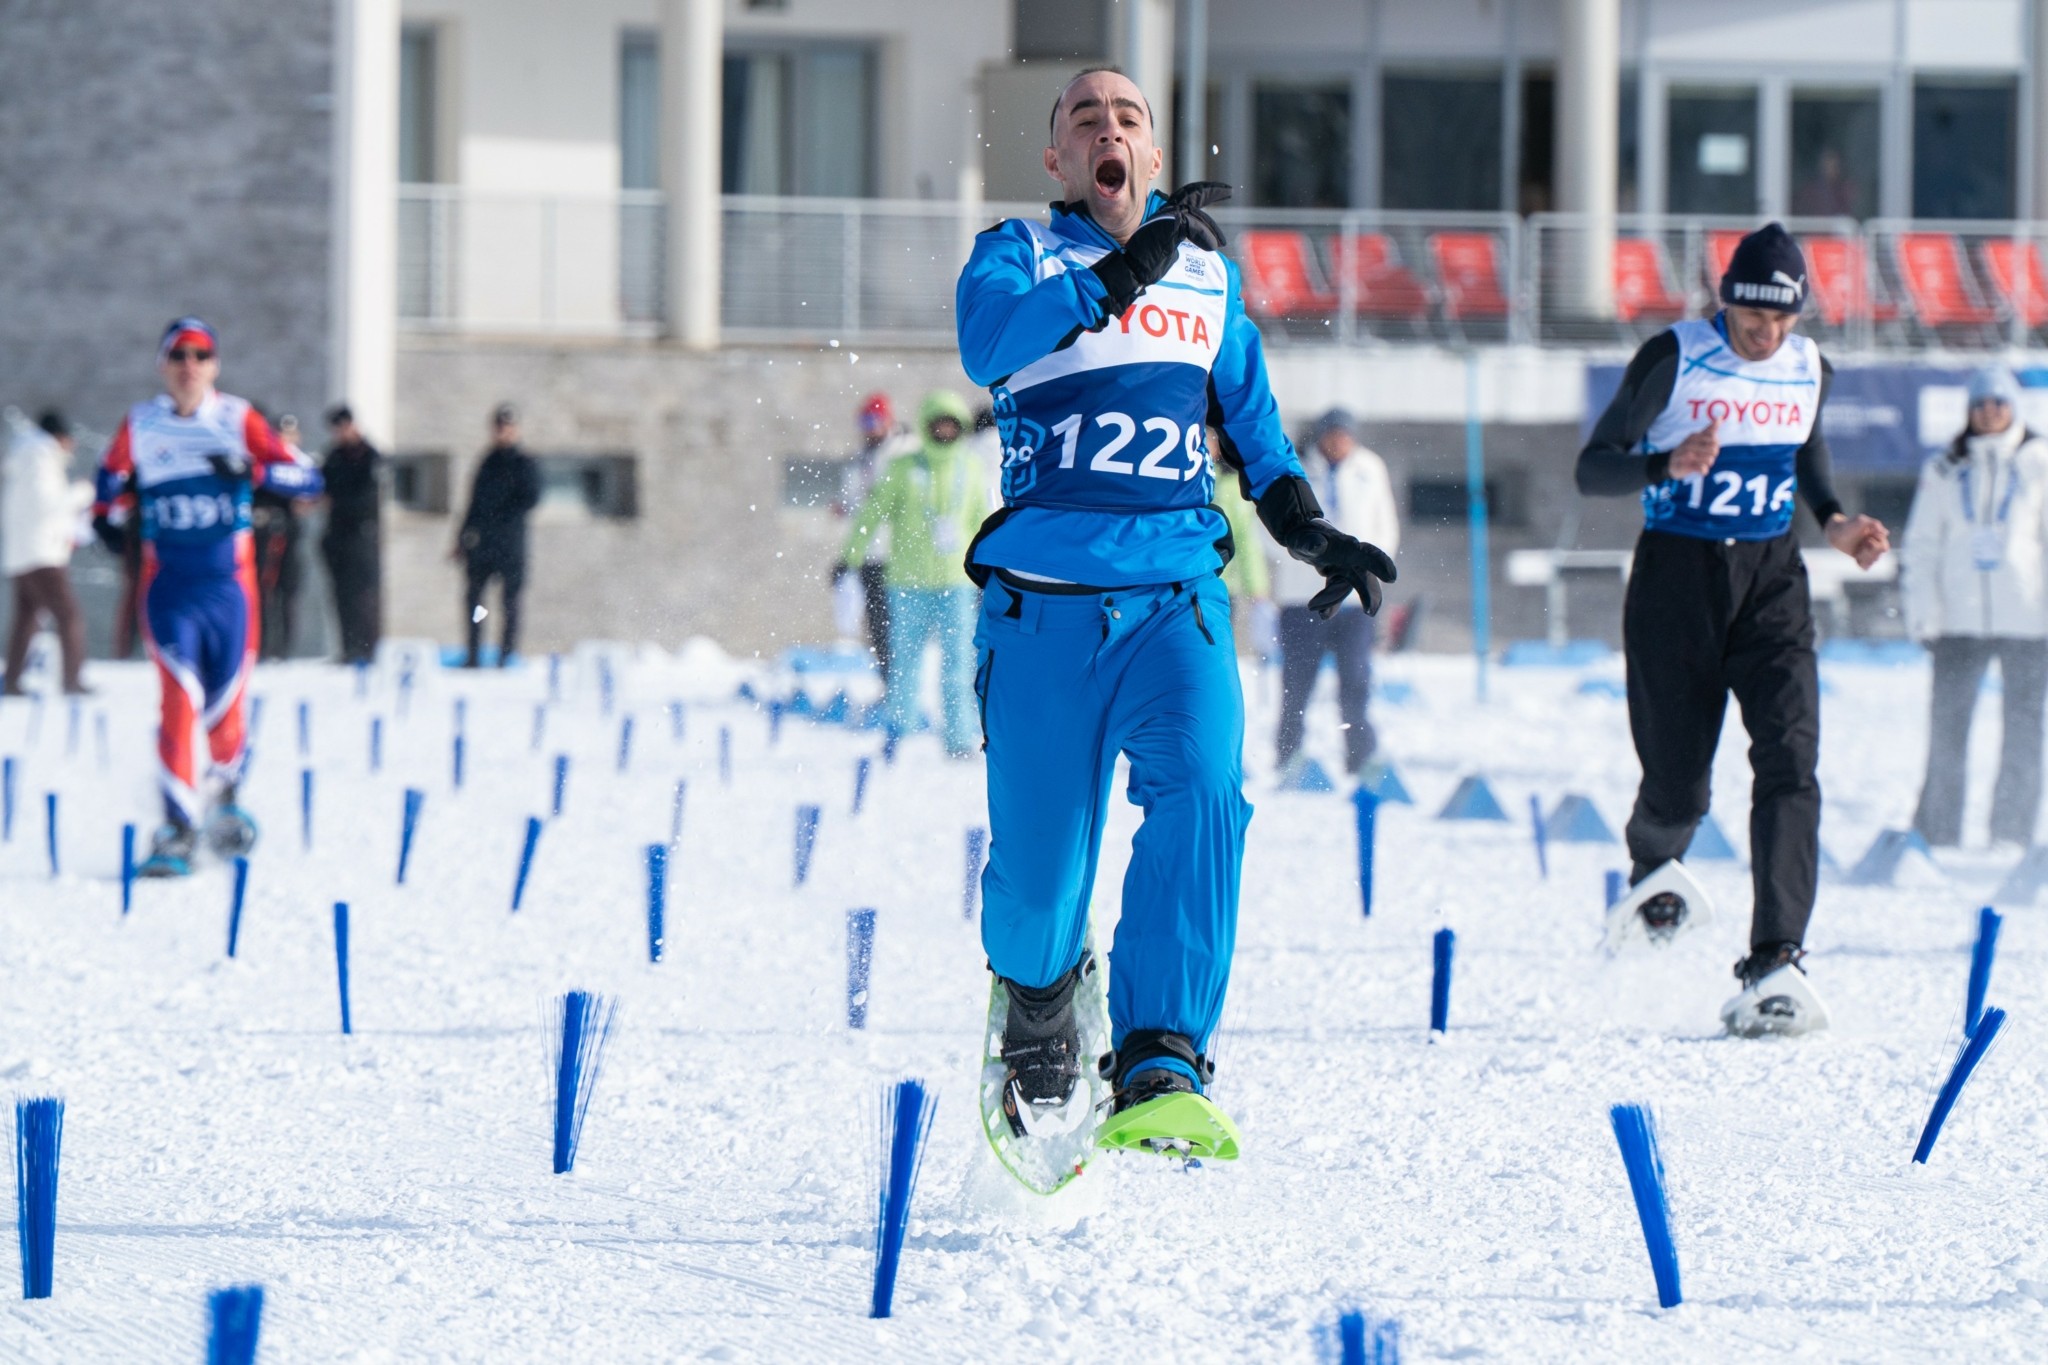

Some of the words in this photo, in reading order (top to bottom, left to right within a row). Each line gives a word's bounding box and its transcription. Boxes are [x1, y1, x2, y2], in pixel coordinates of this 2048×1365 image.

[1184, 266, 1205, 277] GAMES
[1185, 256, 1206, 267] WORLD
[1734, 281, 1795, 304] PUMA
[1085, 304, 1210, 350] YOTA
[1687, 399, 1801, 426] TOYOTA
[1051, 411, 1203, 482] 1229
